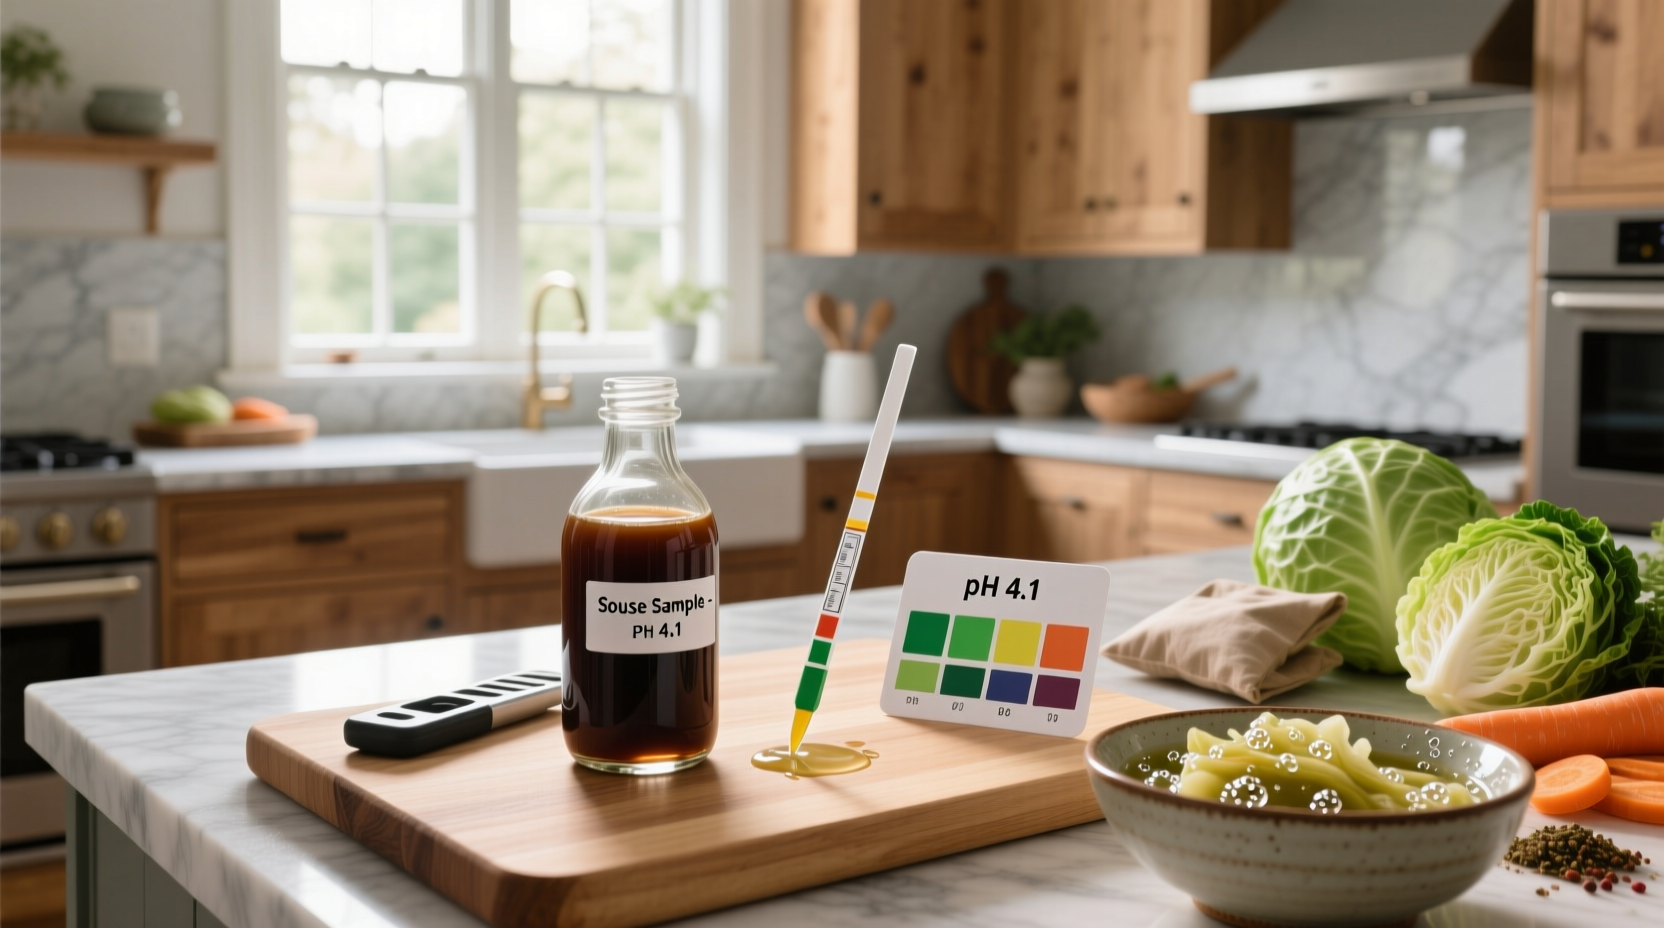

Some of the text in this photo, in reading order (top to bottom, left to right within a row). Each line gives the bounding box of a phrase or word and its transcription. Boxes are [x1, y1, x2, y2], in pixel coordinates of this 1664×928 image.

[963, 575, 1040, 601] pH 4.1
[598, 596, 647, 615] Souse
[652, 593, 705, 617] Sample
[632, 621, 681, 639] PH 4.1
